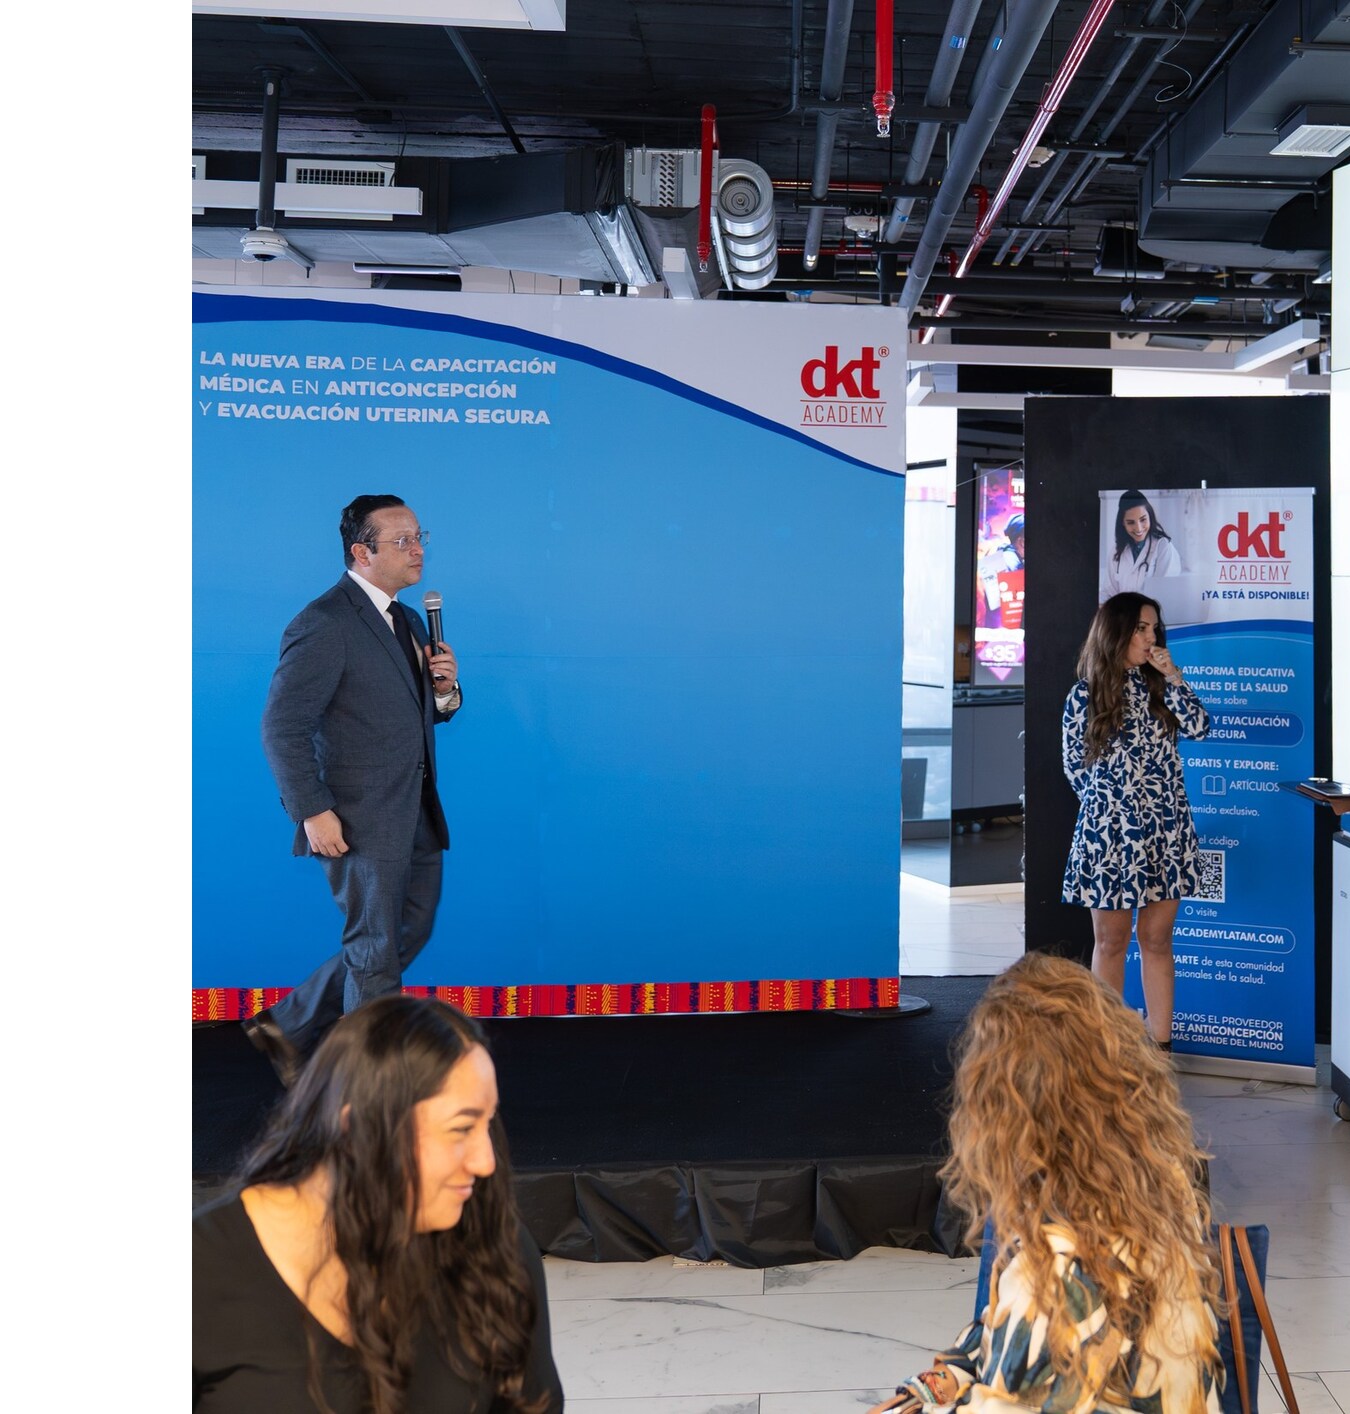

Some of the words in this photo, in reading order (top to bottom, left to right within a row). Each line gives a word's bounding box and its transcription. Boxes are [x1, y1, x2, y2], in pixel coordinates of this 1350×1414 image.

[200, 351, 226, 367] LA
[231, 352, 300, 369] NUEVA
[305, 353, 345, 370] ERA
[351, 355, 377, 371] DE
[382, 356, 405, 372] LA
[410, 353, 556, 375] CAPACITACIÓN
[200, 372, 285, 394] MÉDICA
[292, 379, 319, 395] EN
[325, 378, 516, 400] ANTICONCEPCIÓN
[200, 401, 213, 416] Y
[217, 400, 360, 422] EVACUACIÓN
[366, 405, 459, 424] UTERINA
[465, 406, 550, 425] SEGURA
[803, 404, 885, 425] ACADEMY
[1219, 564, 1290, 581] ACADEMY
[1202, 590, 1219, 602] ¡YA
[1222, 588, 1245, 600] ESTÁ
[1248, 590, 1310, 601] DISPONIBLE!
[1182, 665, 1235, 676] ATAFORMA
[1238, 667, 1295, 678] EDUCATIVA
[1224, 682, 1238, 692] DE
[1240, 683, 1252, 692] LA
[1255, 683, 1288, 693] SALUD
[1223, 696, 1248, 705] sobre
[1213, 715, 1219, 725] Y
[1222, 715, 1290, 727] EVACUACIÓN
[1208, 729, 1246, 739] SEGURA
[1187, 758, 1222, 768] GRATIS
[1225, 759, 1231, 768] Y
[1233, 760, 1279, 771] EXPLORE:
[1229, 779, 1280, 792] ARTÍCULOS
[1190, 804, 1217, 814] tenido
[1219, 806, 1260, 817] exclusivo.
[1199, 836, 1206, 845] el
[1209, 836, 1240, 848] código
[1185, 905, 1194, 915] O
[1195, 907, 1218, 918] visite
[1201, 957, 1213, 966] de
[1215, 959, 1233, 968] esta
[1235, 961, 1285, 973] comunidad
[1174, 970, 1213, 980] esionales
[1215, 971, 1226, 981] de
[1229, 972, 1237, 982] la
[1239, 974, 1266, 985] salud.
[1172, 1011, 1206, 1023] SOMOS
[1208, 1015, 1219, 1024] EL
[1222, 1016, 1284, 1030] PROVEEDOR
[1172, 1022, 1185, 1031] DE
[1187, 1023, 1283, 1041] ANTICONCEPCIÓN
[1172, 1030, 1190, 1040] MÁS
[1191, 1034, 1228, 1045] GRANDE
[1230, 1037, 1247, 1047] DEL
[1249, 1040, 1284, 1051] MUNDO
